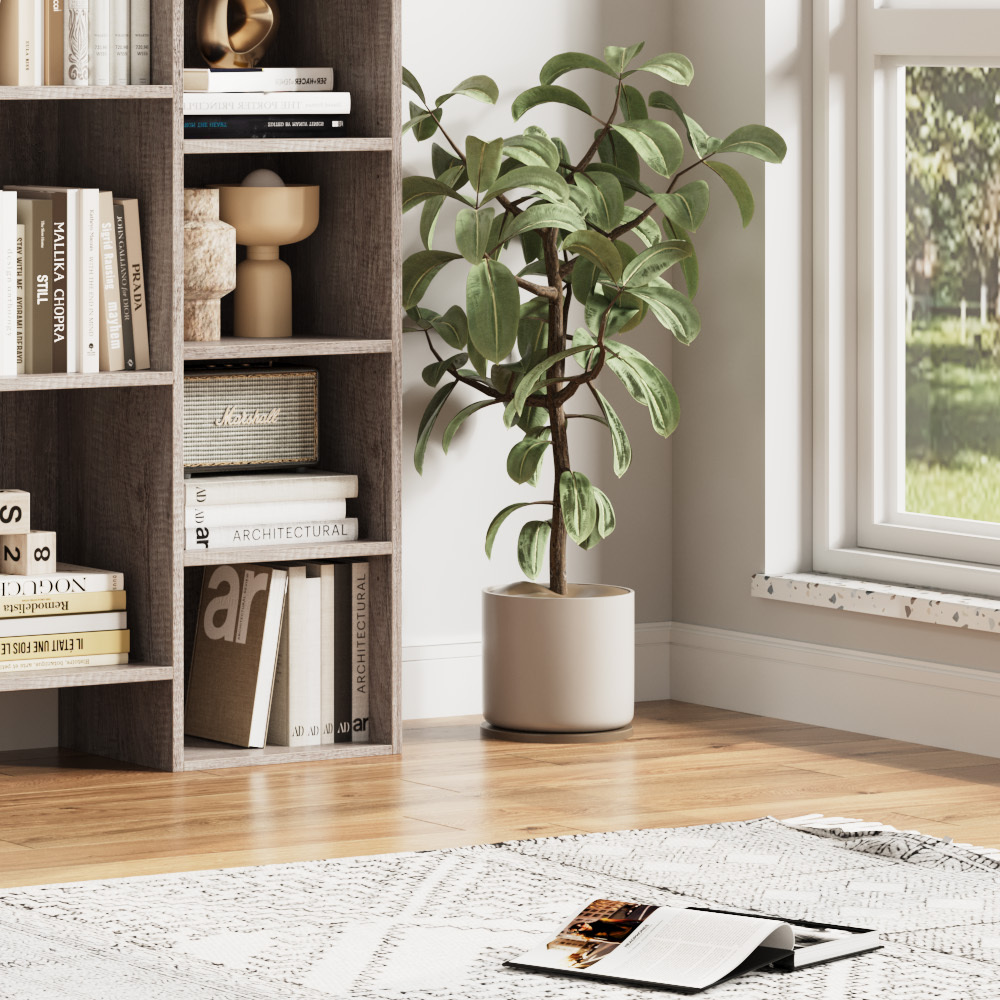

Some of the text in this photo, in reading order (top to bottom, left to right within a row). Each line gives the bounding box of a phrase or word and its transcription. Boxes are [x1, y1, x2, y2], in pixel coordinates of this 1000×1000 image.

[116, 216, 124, 240] JOHN
[101, 222, 116, 290] Sigrid Rausing
[118, 241, 127, 286] GALLIANO
[37, 274, 48, 305] STILL
[54, 222, 64, 343] MALLIKA CHOPRA
[132, 264, 142, 311] PRADA
[122, 298, 130, 320] DIOR
[107, 302, 122, 350] mayhem
[215, 405, 281, 426] Marshall
[196, 486, 207, 503] AD
[0, 505, 22, 523] S
[196, 527, 209, 548] ar
[233, 524, 348, 542] ARCHITECTURAL
[4, 545, 21, 562] 2
[34, 546, 51, 562] 8
[3, 600, 69, 613] Remodelista
[203, 565, 269, 644] ar
[357, 573, 366, 694] ARCHITECTURAL
[1, 643, 11, 654] LE
[13, 642, 31, 654] FOIS
[33, 641, 50, 652] UNE
[52, 639, 74, 653] ÉTAIT
[77, 638, 84, 649] IL
[292, 725, 304, 737] AD
[308, 725, 319, 736] AD
[324, 723, 333, 734] AD
[337, 722, 349, 733] AD
[353, 717, 369, 732] ar
